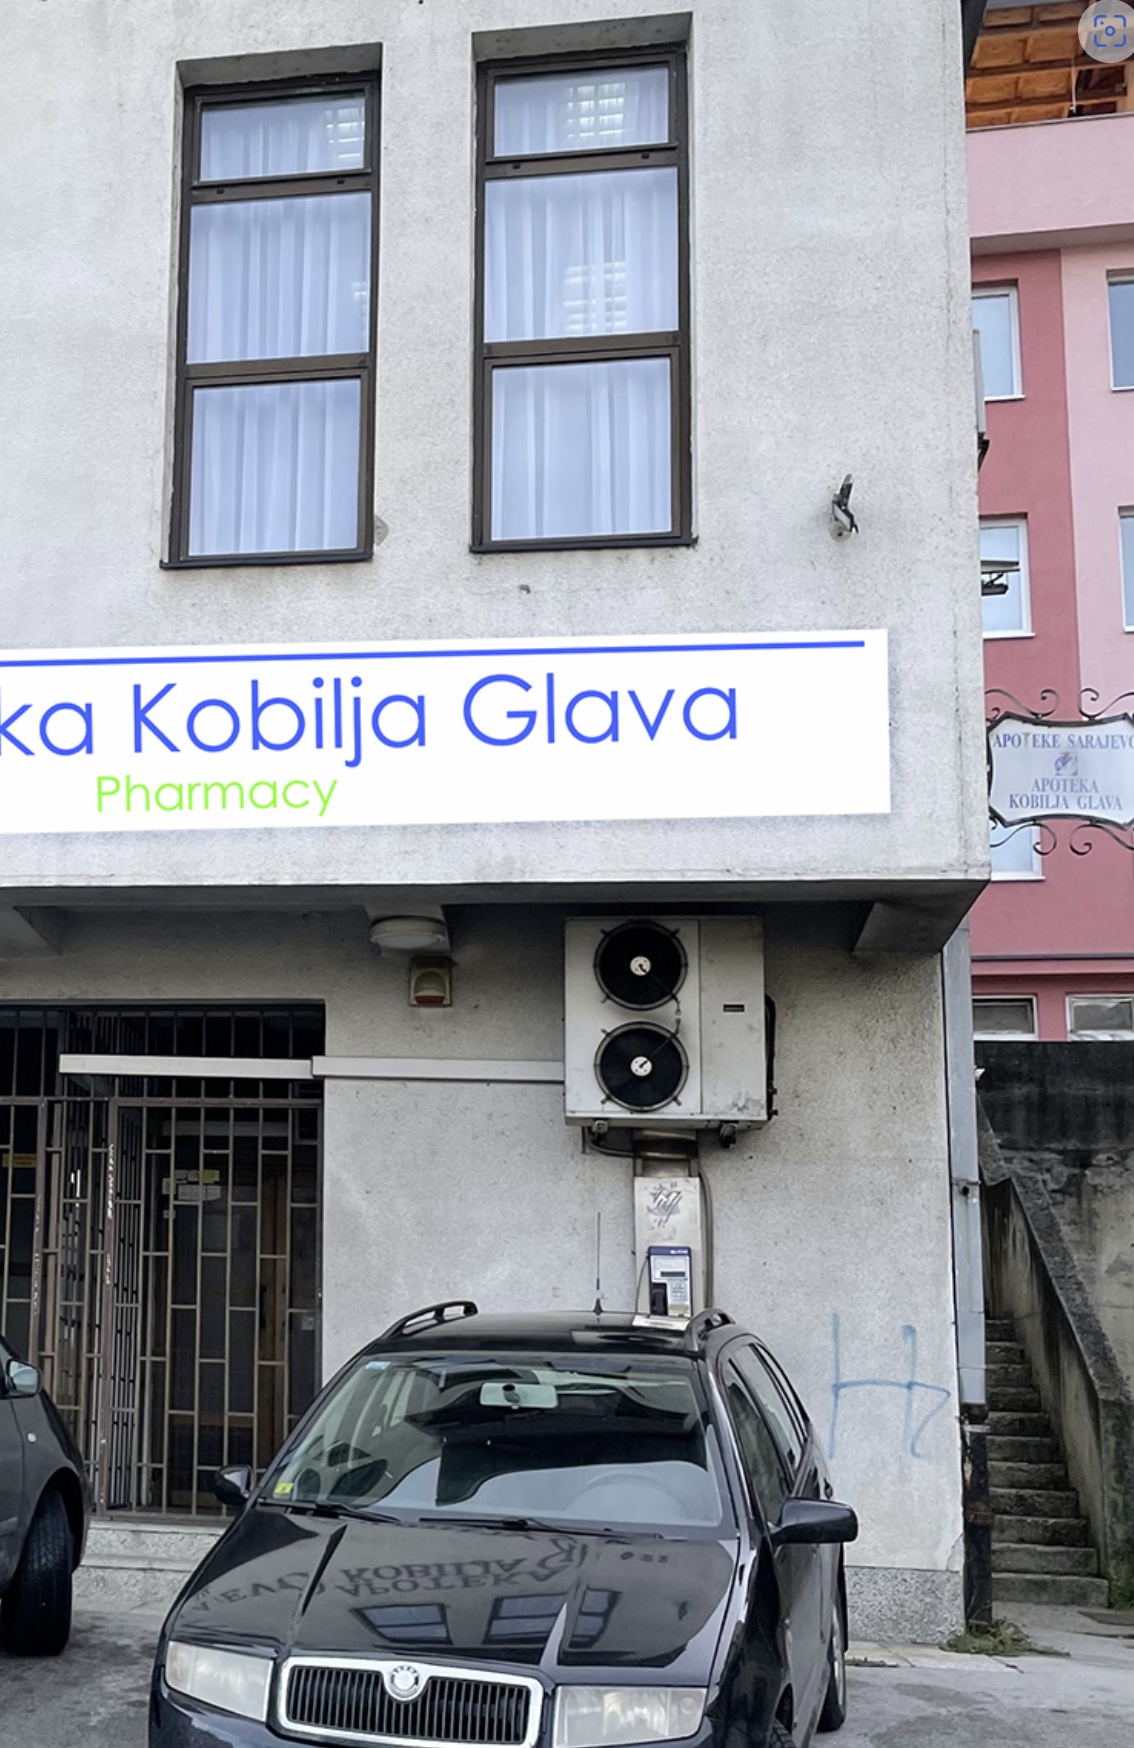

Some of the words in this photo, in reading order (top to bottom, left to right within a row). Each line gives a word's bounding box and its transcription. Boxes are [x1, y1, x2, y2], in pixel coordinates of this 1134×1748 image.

[133, 676, 425, 769] Kobilja
[463, 673, 737, 747] Glava
[994, 732, 1061, 749] APOTEKE
[1032, 778, 1099, 794] APOTEKA
[97, 775, 337, 817] Pharmacy
[1009, 793, 1069, 810] KOBILJA
[1077, 795, 1123, 811] GLAVA
